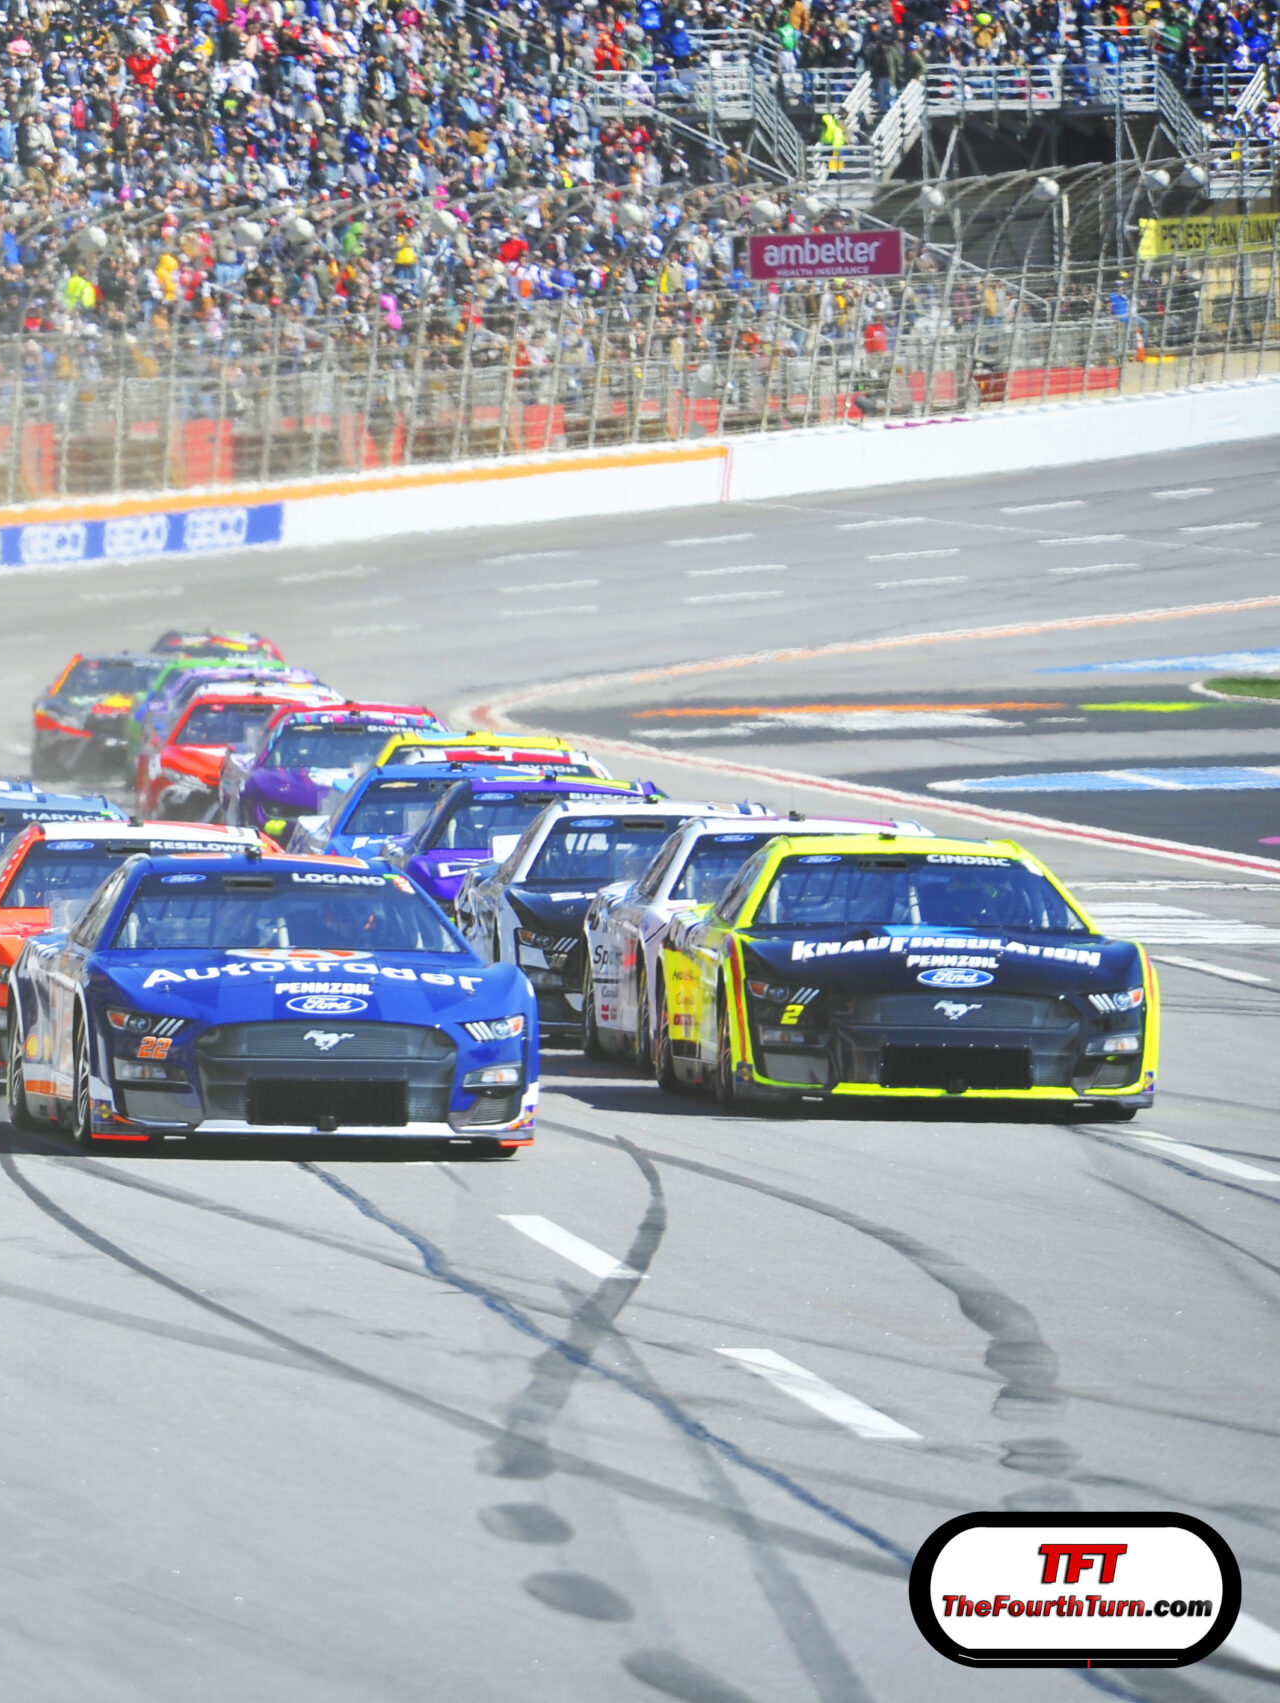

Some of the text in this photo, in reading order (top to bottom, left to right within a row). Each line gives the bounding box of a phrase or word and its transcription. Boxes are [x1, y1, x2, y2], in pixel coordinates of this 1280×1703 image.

[763, 236, 880, 266] ambetter
[776, 265, 869, 277] HEALTH INSURANCE
[926, 854, 1012, 866] CINDRIC
[292, 872, 386, 887] LOGANO
[791, 936, 1101, 967] KNAUF INSULATION
[906, 954, 1000, 969] PENNZOIL
[143, 959, 483, 989] Autotrader
[274, 982, 374, 996] PENNZOIL
[780, 1004, 805, 1025] 2
[137, 1036, 172, 1059] 22
